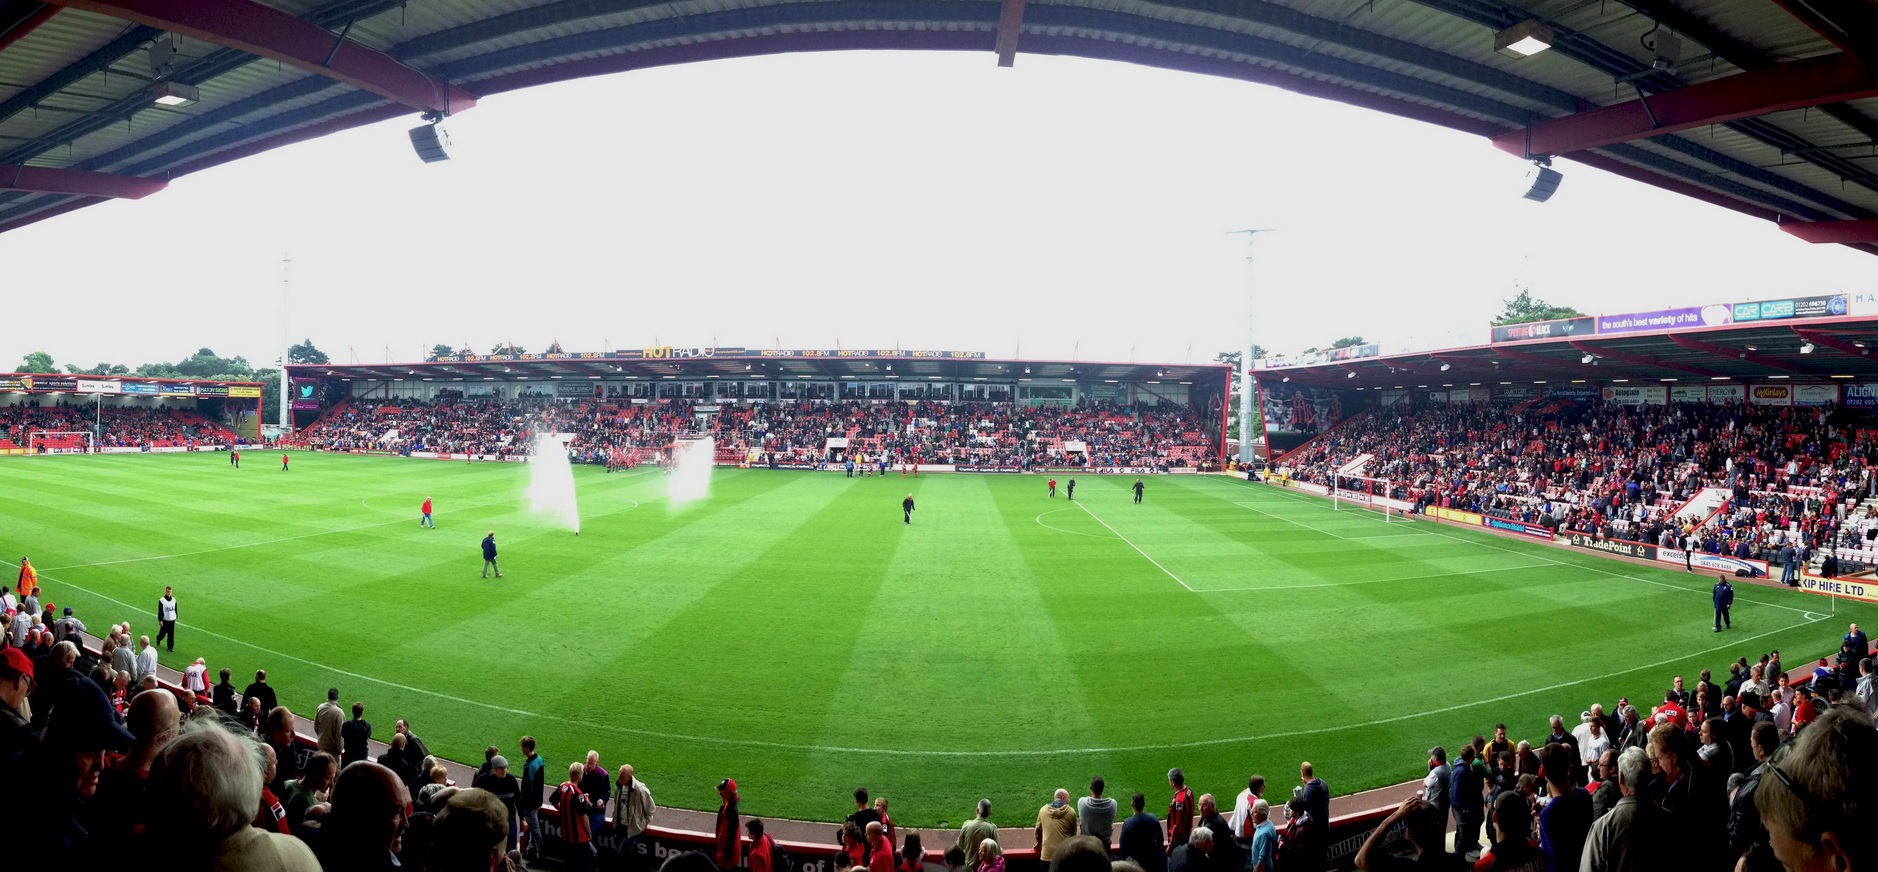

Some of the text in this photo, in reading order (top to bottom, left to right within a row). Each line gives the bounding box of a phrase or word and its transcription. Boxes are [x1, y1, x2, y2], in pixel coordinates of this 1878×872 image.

[1734, 305, 1758, 315] CAR
[1602, 313, 1698, 329] the south's best variety of hits
[1847, 386, 1875, 397] ALIGN
[1583, 536, 1632, 554] TradePoint
[1819, 580, 1842, 593] HIRE
[1845, 584, 1864, 596] LTD
